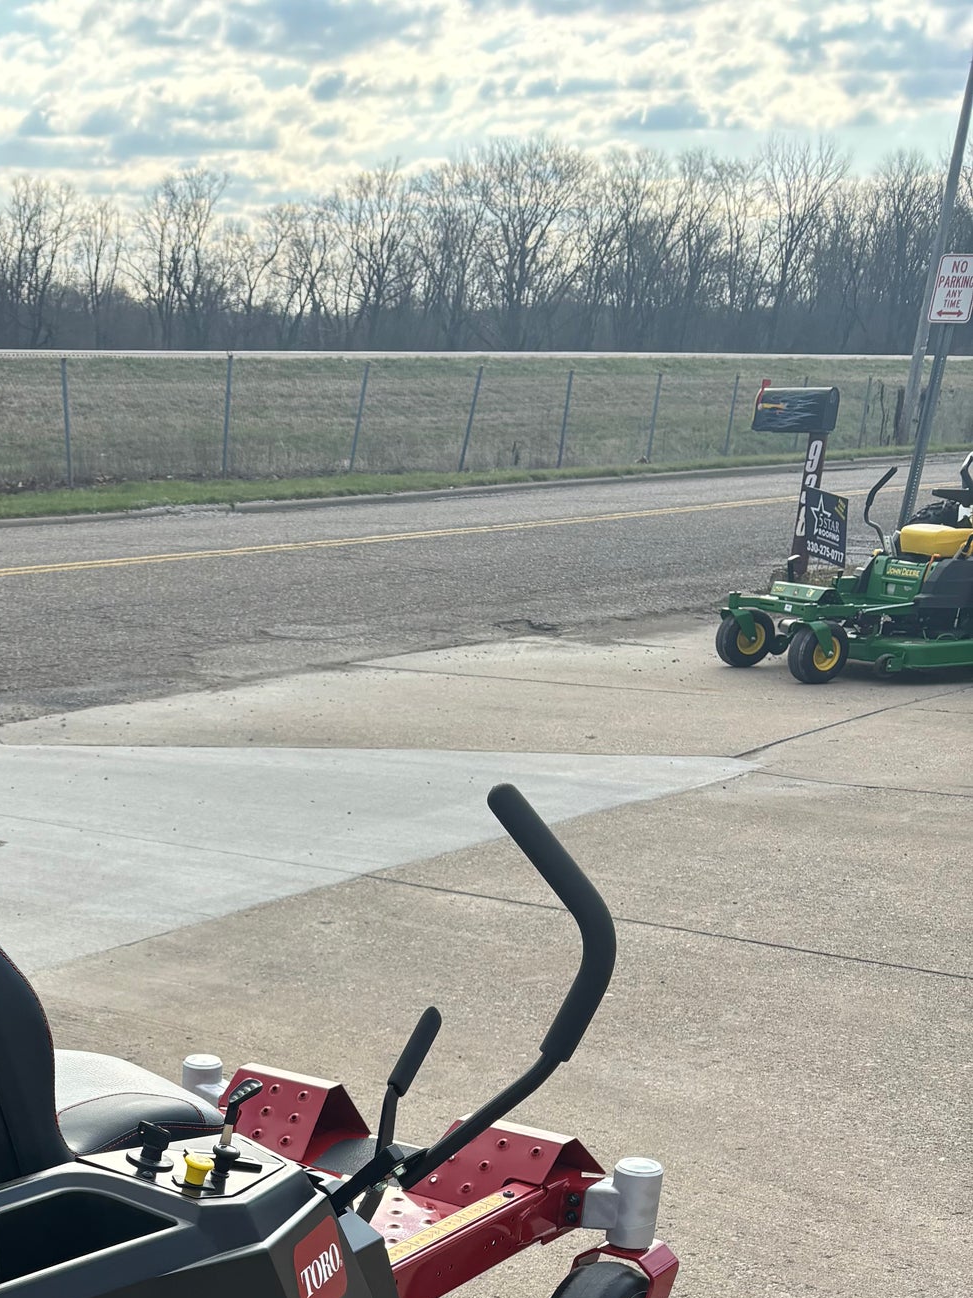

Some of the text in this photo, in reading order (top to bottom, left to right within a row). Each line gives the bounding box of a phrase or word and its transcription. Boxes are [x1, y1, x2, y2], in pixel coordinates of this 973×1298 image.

[951, 260, 969, 273] NO
[938, 276, 973, 288] PARKING
[946, 289, 963, 298] ANY
[943, 299, 962, 308] TIME
[824, 517, 841, 534] STAR
[818, 529, 840, 542] ROOFING
[887, 566, 921, 578] JOHN DEERE
[300, 1243, 340, 1298] TORO
